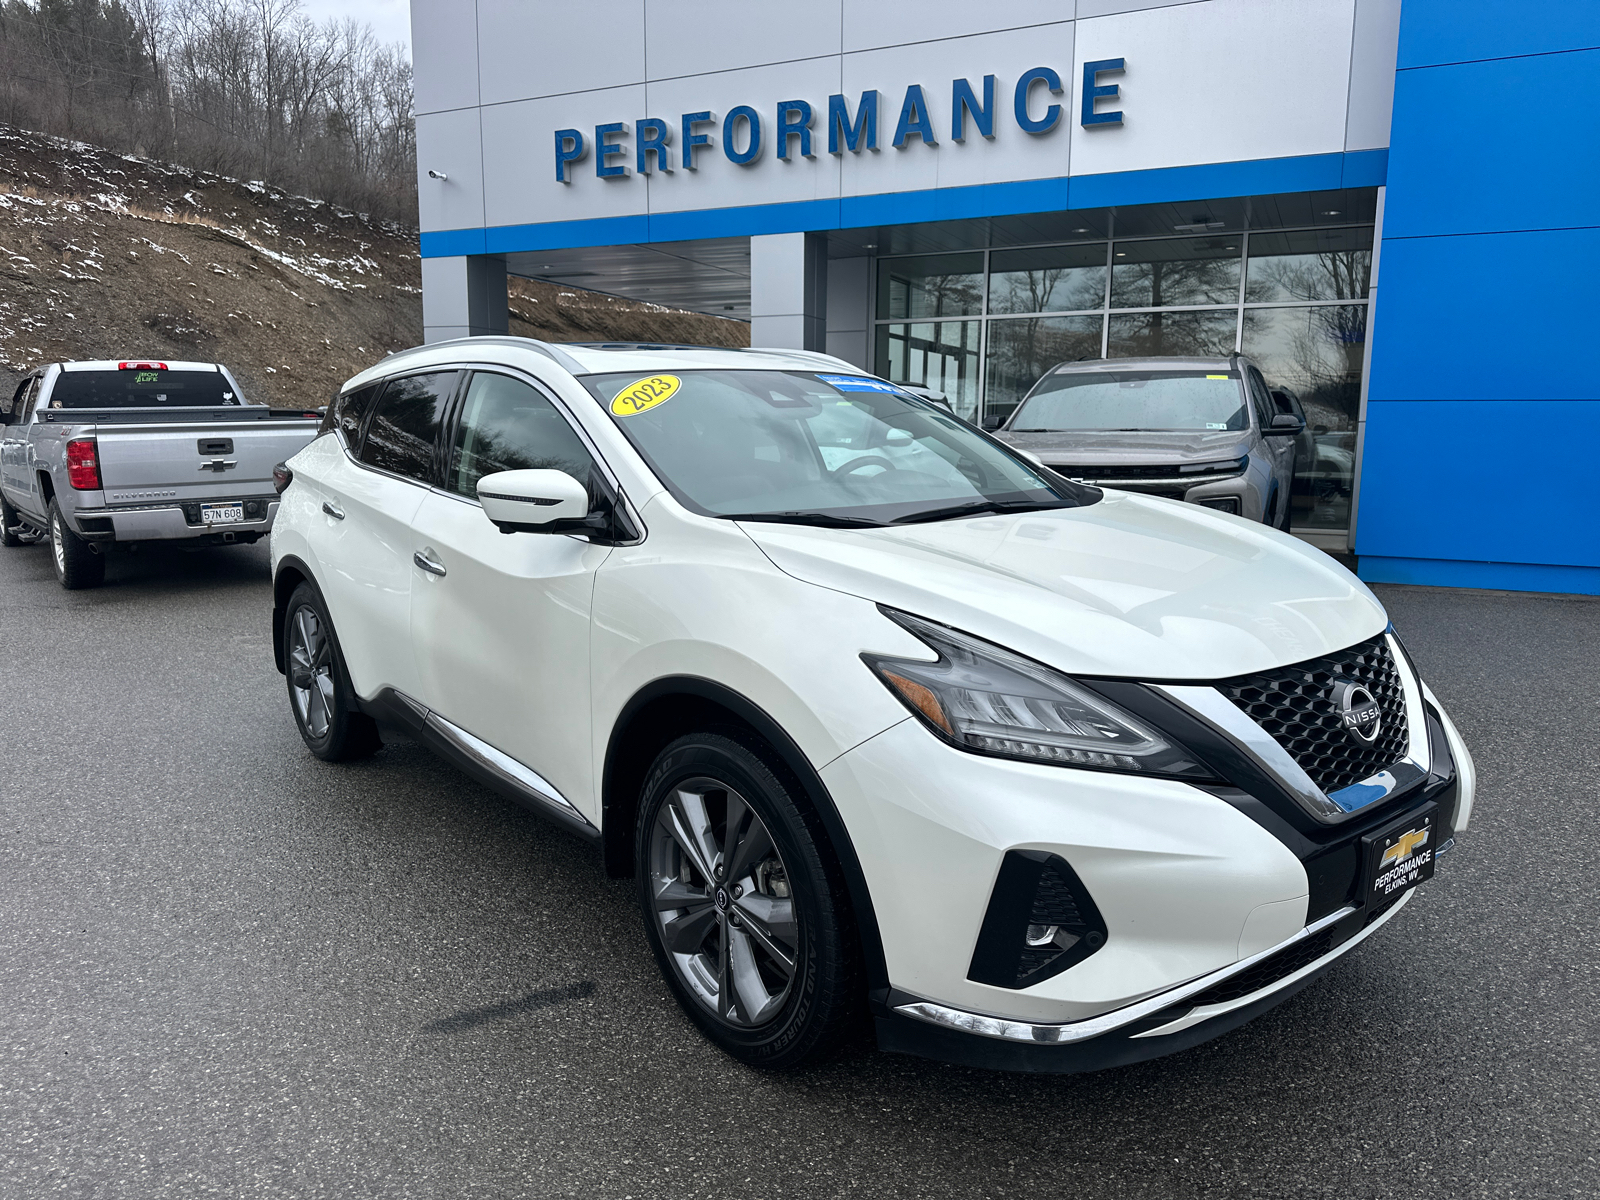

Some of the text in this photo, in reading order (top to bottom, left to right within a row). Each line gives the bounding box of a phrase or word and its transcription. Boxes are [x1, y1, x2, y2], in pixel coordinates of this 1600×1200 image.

[553, 56, 1127, 185] PERFORMANCE
[622, 378, 672, 411] 2023
[113, 490, 176, 500] SILVERADO
[203, 508, 242, 520] 57N 608
[1345, 706, 1380, 726] NISSA
[1374, 849, 1432, 892] PERFORMANCE
[1384, 874, 1408, 895] ELKINS,
[1408, 868, 1419, 881] WV
[806, 909, 818, 995] GRAND
[775, 997, 812, 1052] TOURER
